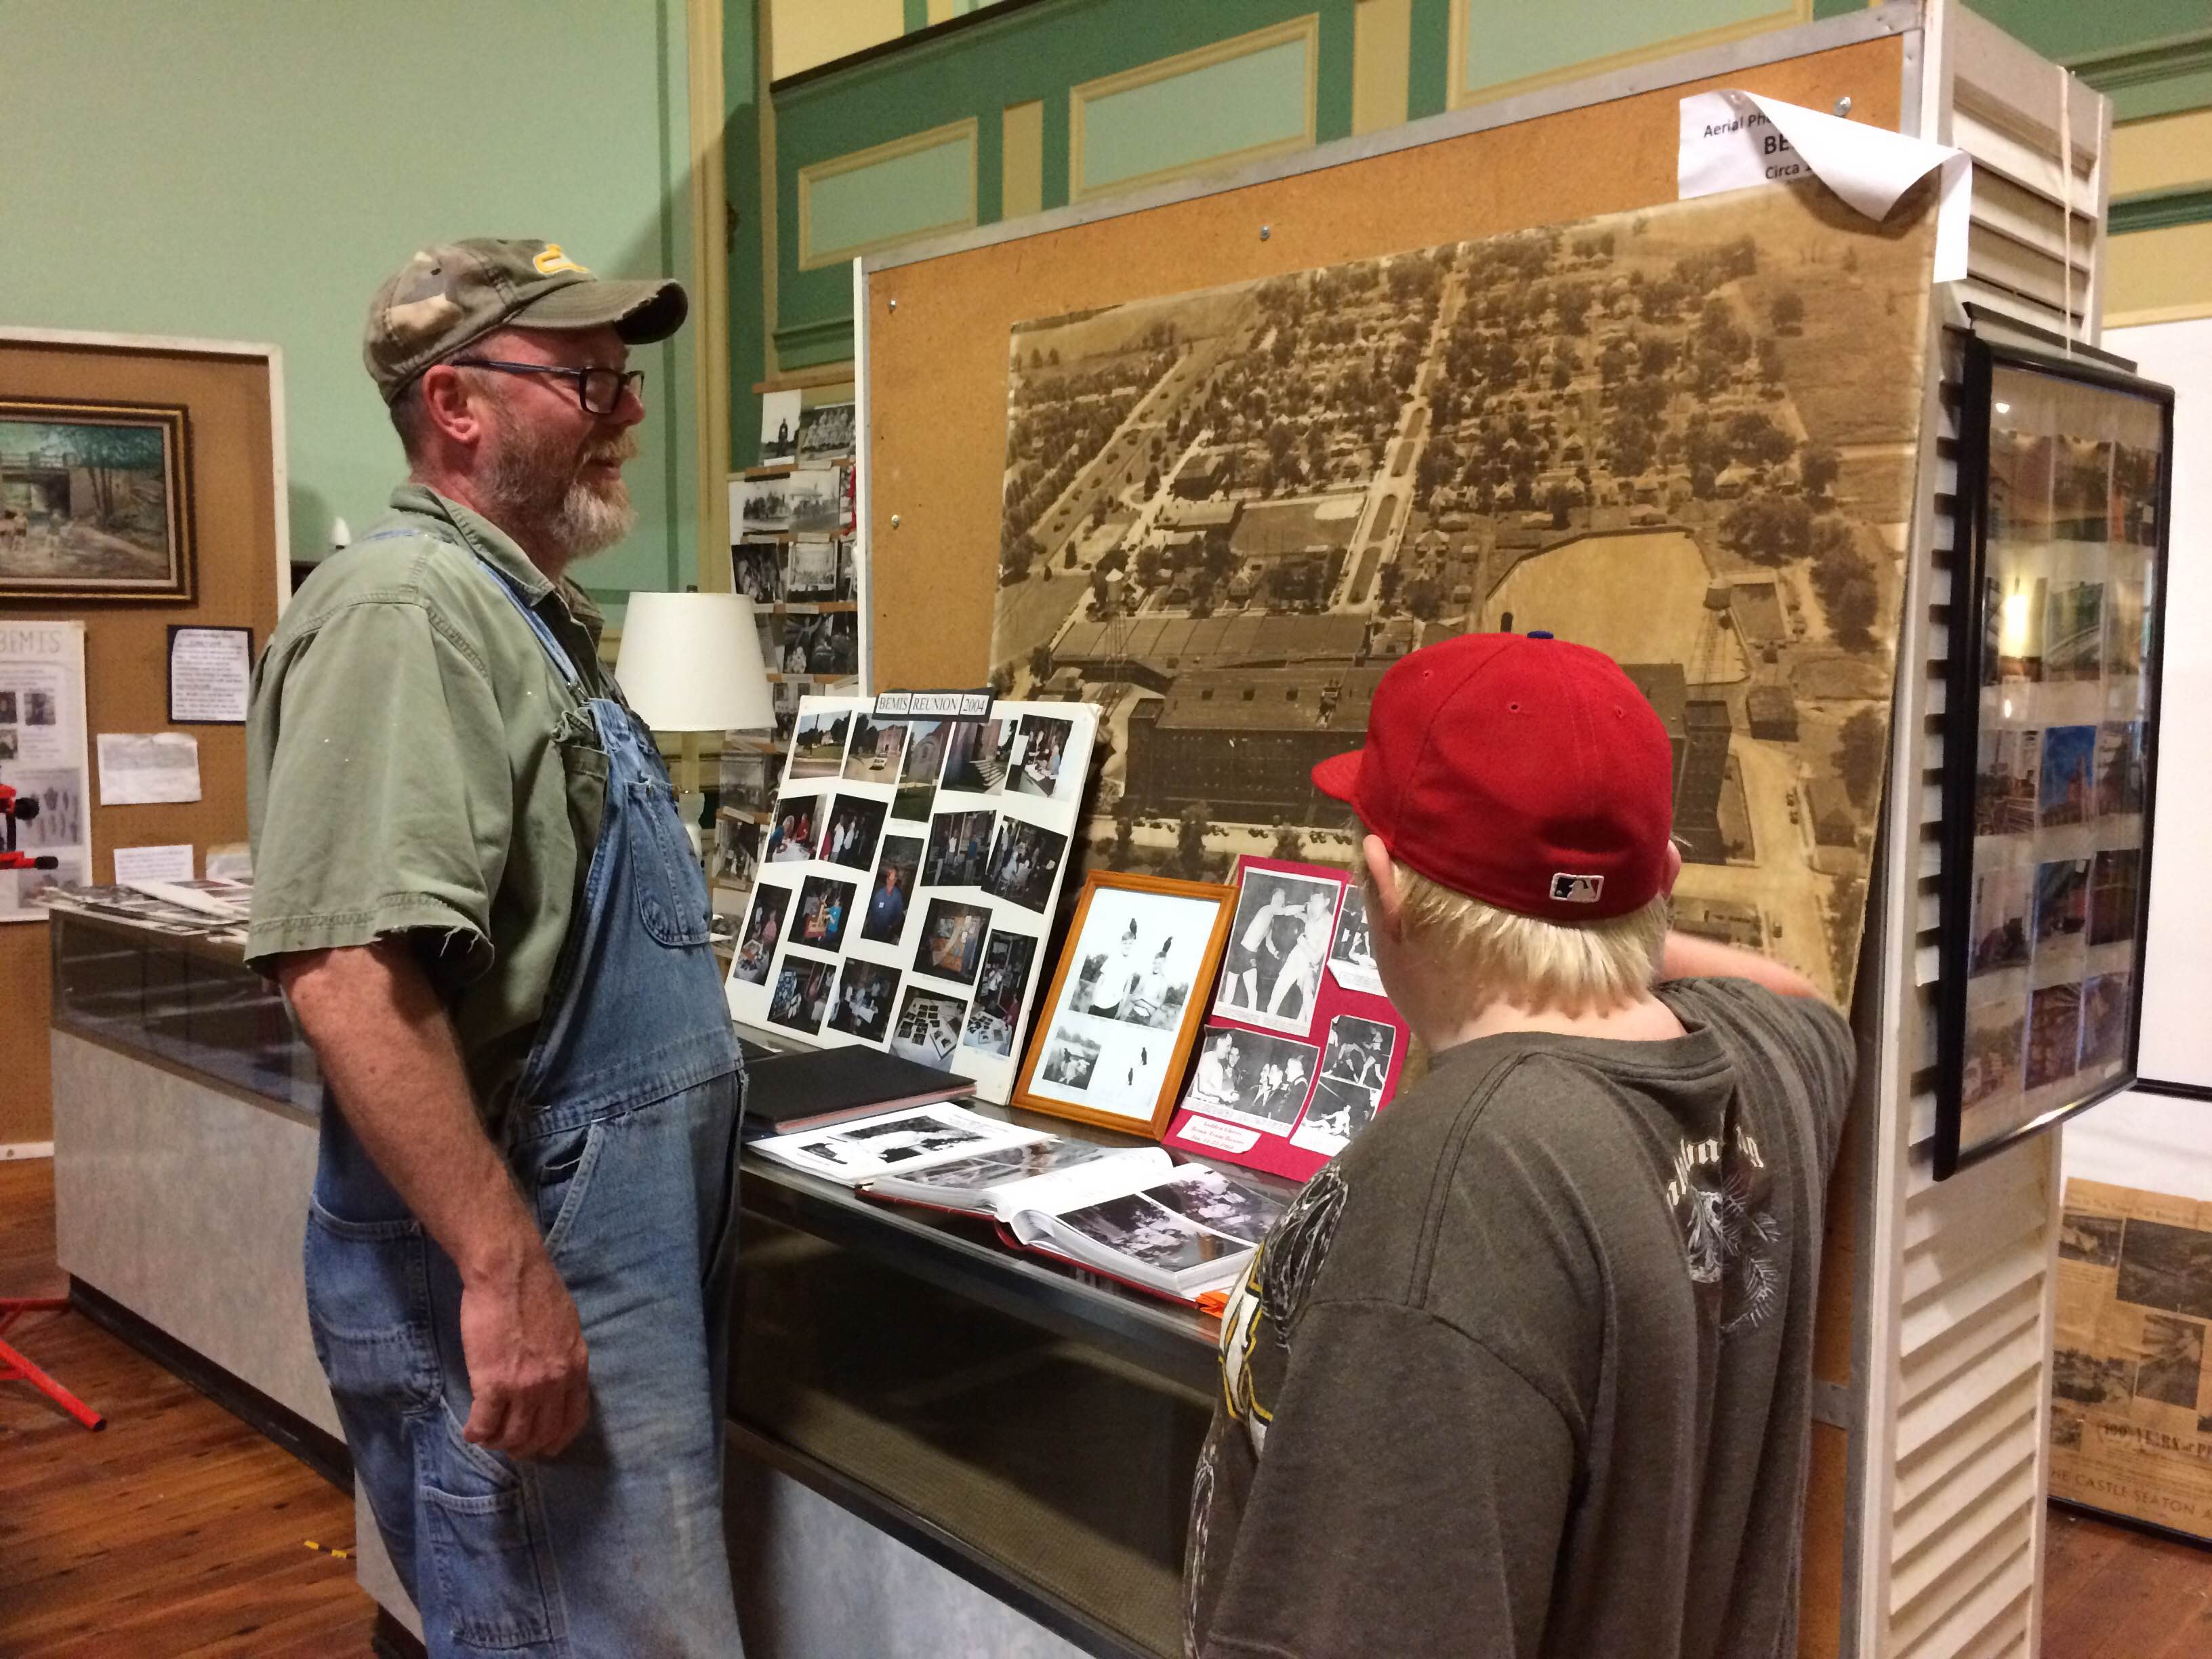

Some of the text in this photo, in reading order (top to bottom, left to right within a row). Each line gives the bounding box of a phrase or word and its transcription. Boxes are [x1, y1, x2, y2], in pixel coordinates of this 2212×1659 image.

[1704, 116, 1744, 138] Aerial
[1765, 163, 1800, 180] Circa
[878, 696, 986, 712] BEMIS REUNION 2004
